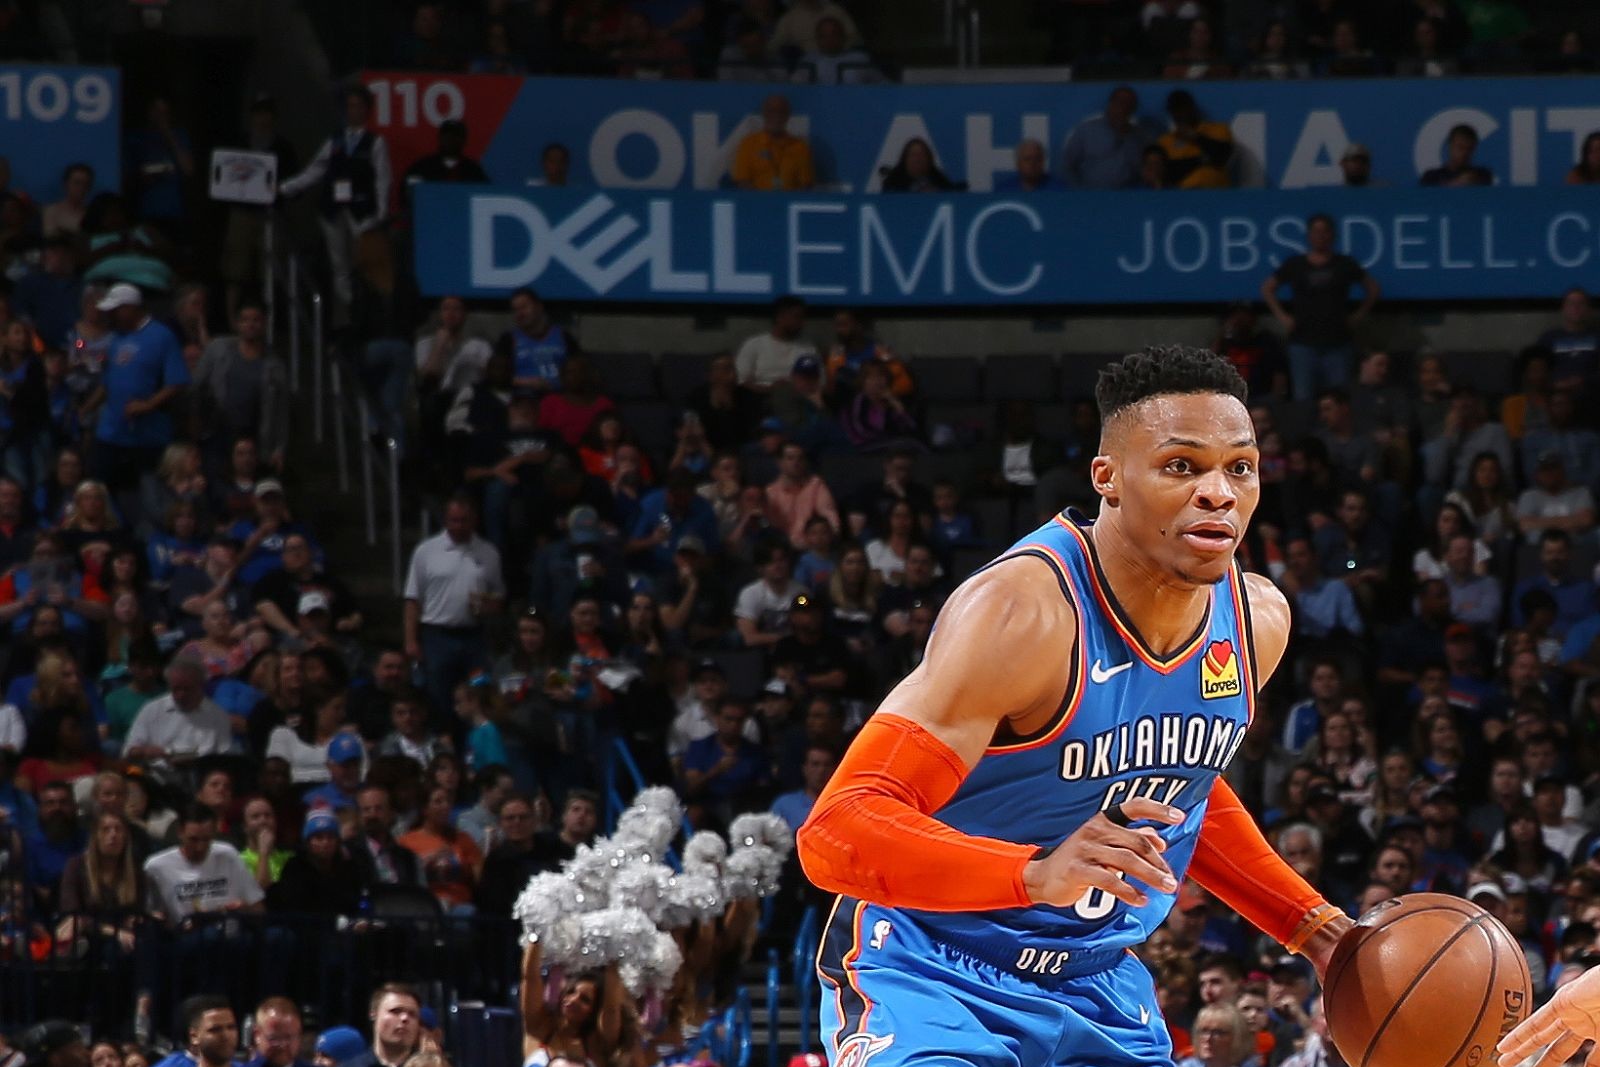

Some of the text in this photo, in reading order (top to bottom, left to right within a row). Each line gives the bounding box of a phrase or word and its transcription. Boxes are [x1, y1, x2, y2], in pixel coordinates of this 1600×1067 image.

[0, 73, 112, 123] 109
[367, 79, 466, 128] 110
[1060, 713, 1246, 781] OKLAHOMA
[1101, 778, 1188, 811] CITY
[1016, 947, 1069, 975] OKC
